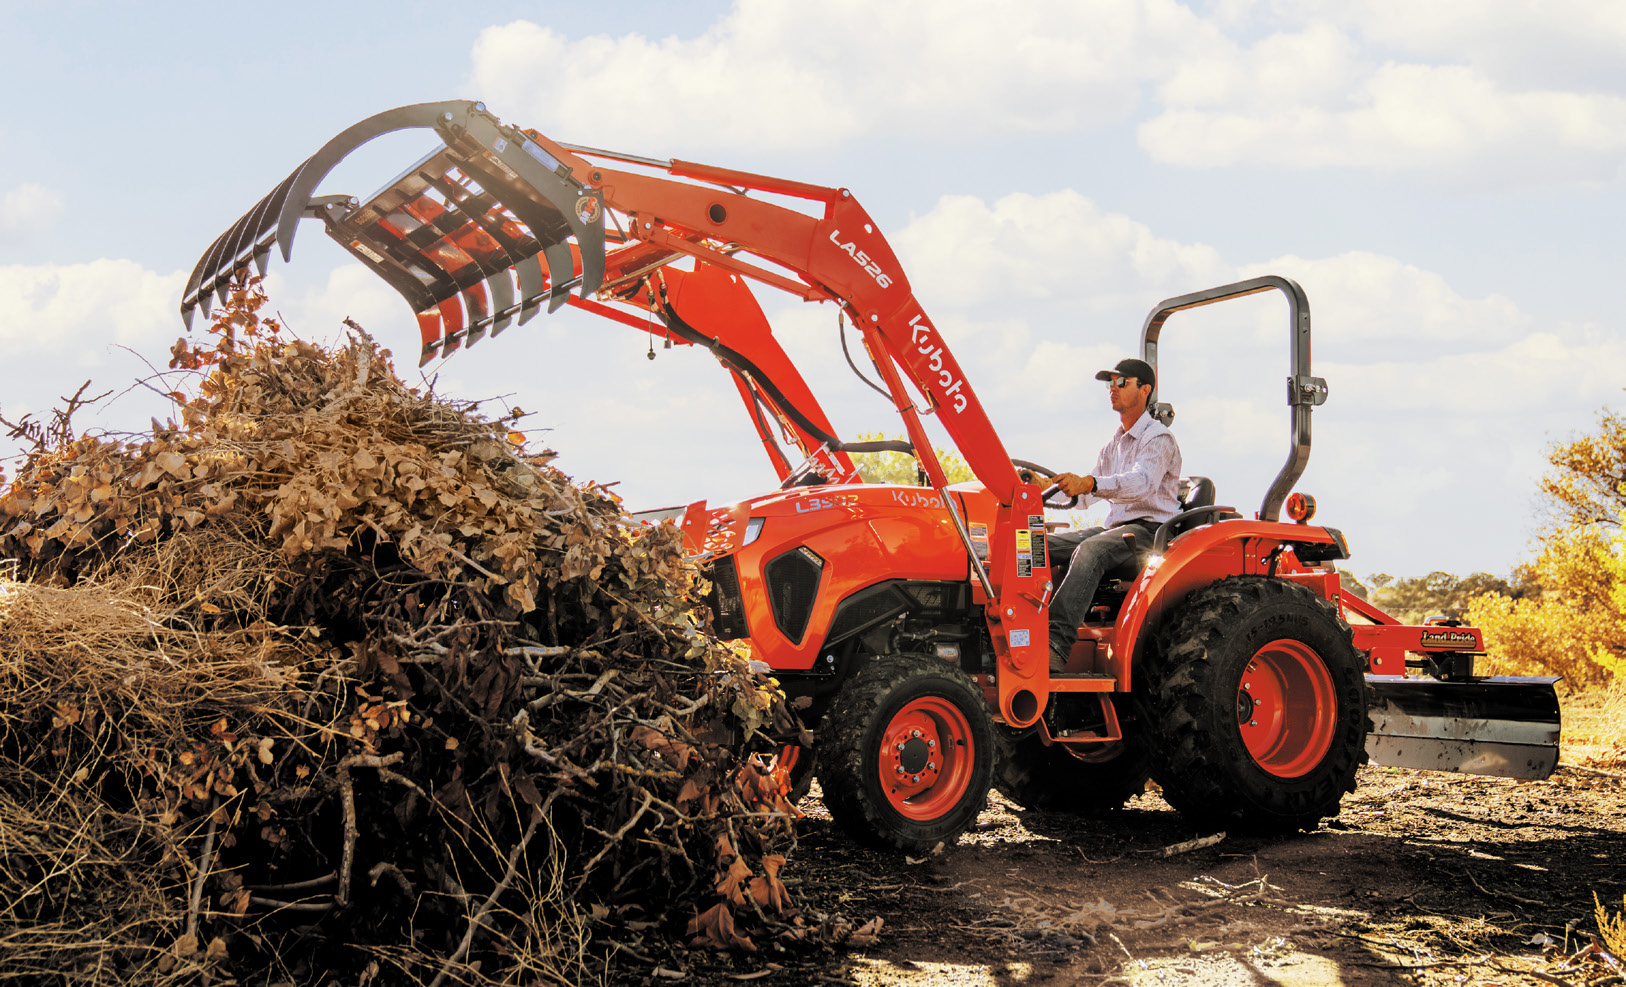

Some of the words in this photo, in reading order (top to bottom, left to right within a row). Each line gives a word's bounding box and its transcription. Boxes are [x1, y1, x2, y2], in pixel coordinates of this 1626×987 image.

[829, 230, 893, 288] LA526
[908, 314, 967, 414] Kubota
[892, 490, 958, 510] Kubot
[1422, 631, 1447, 643] Land
[1449, 632, 1475, 644] Pride
